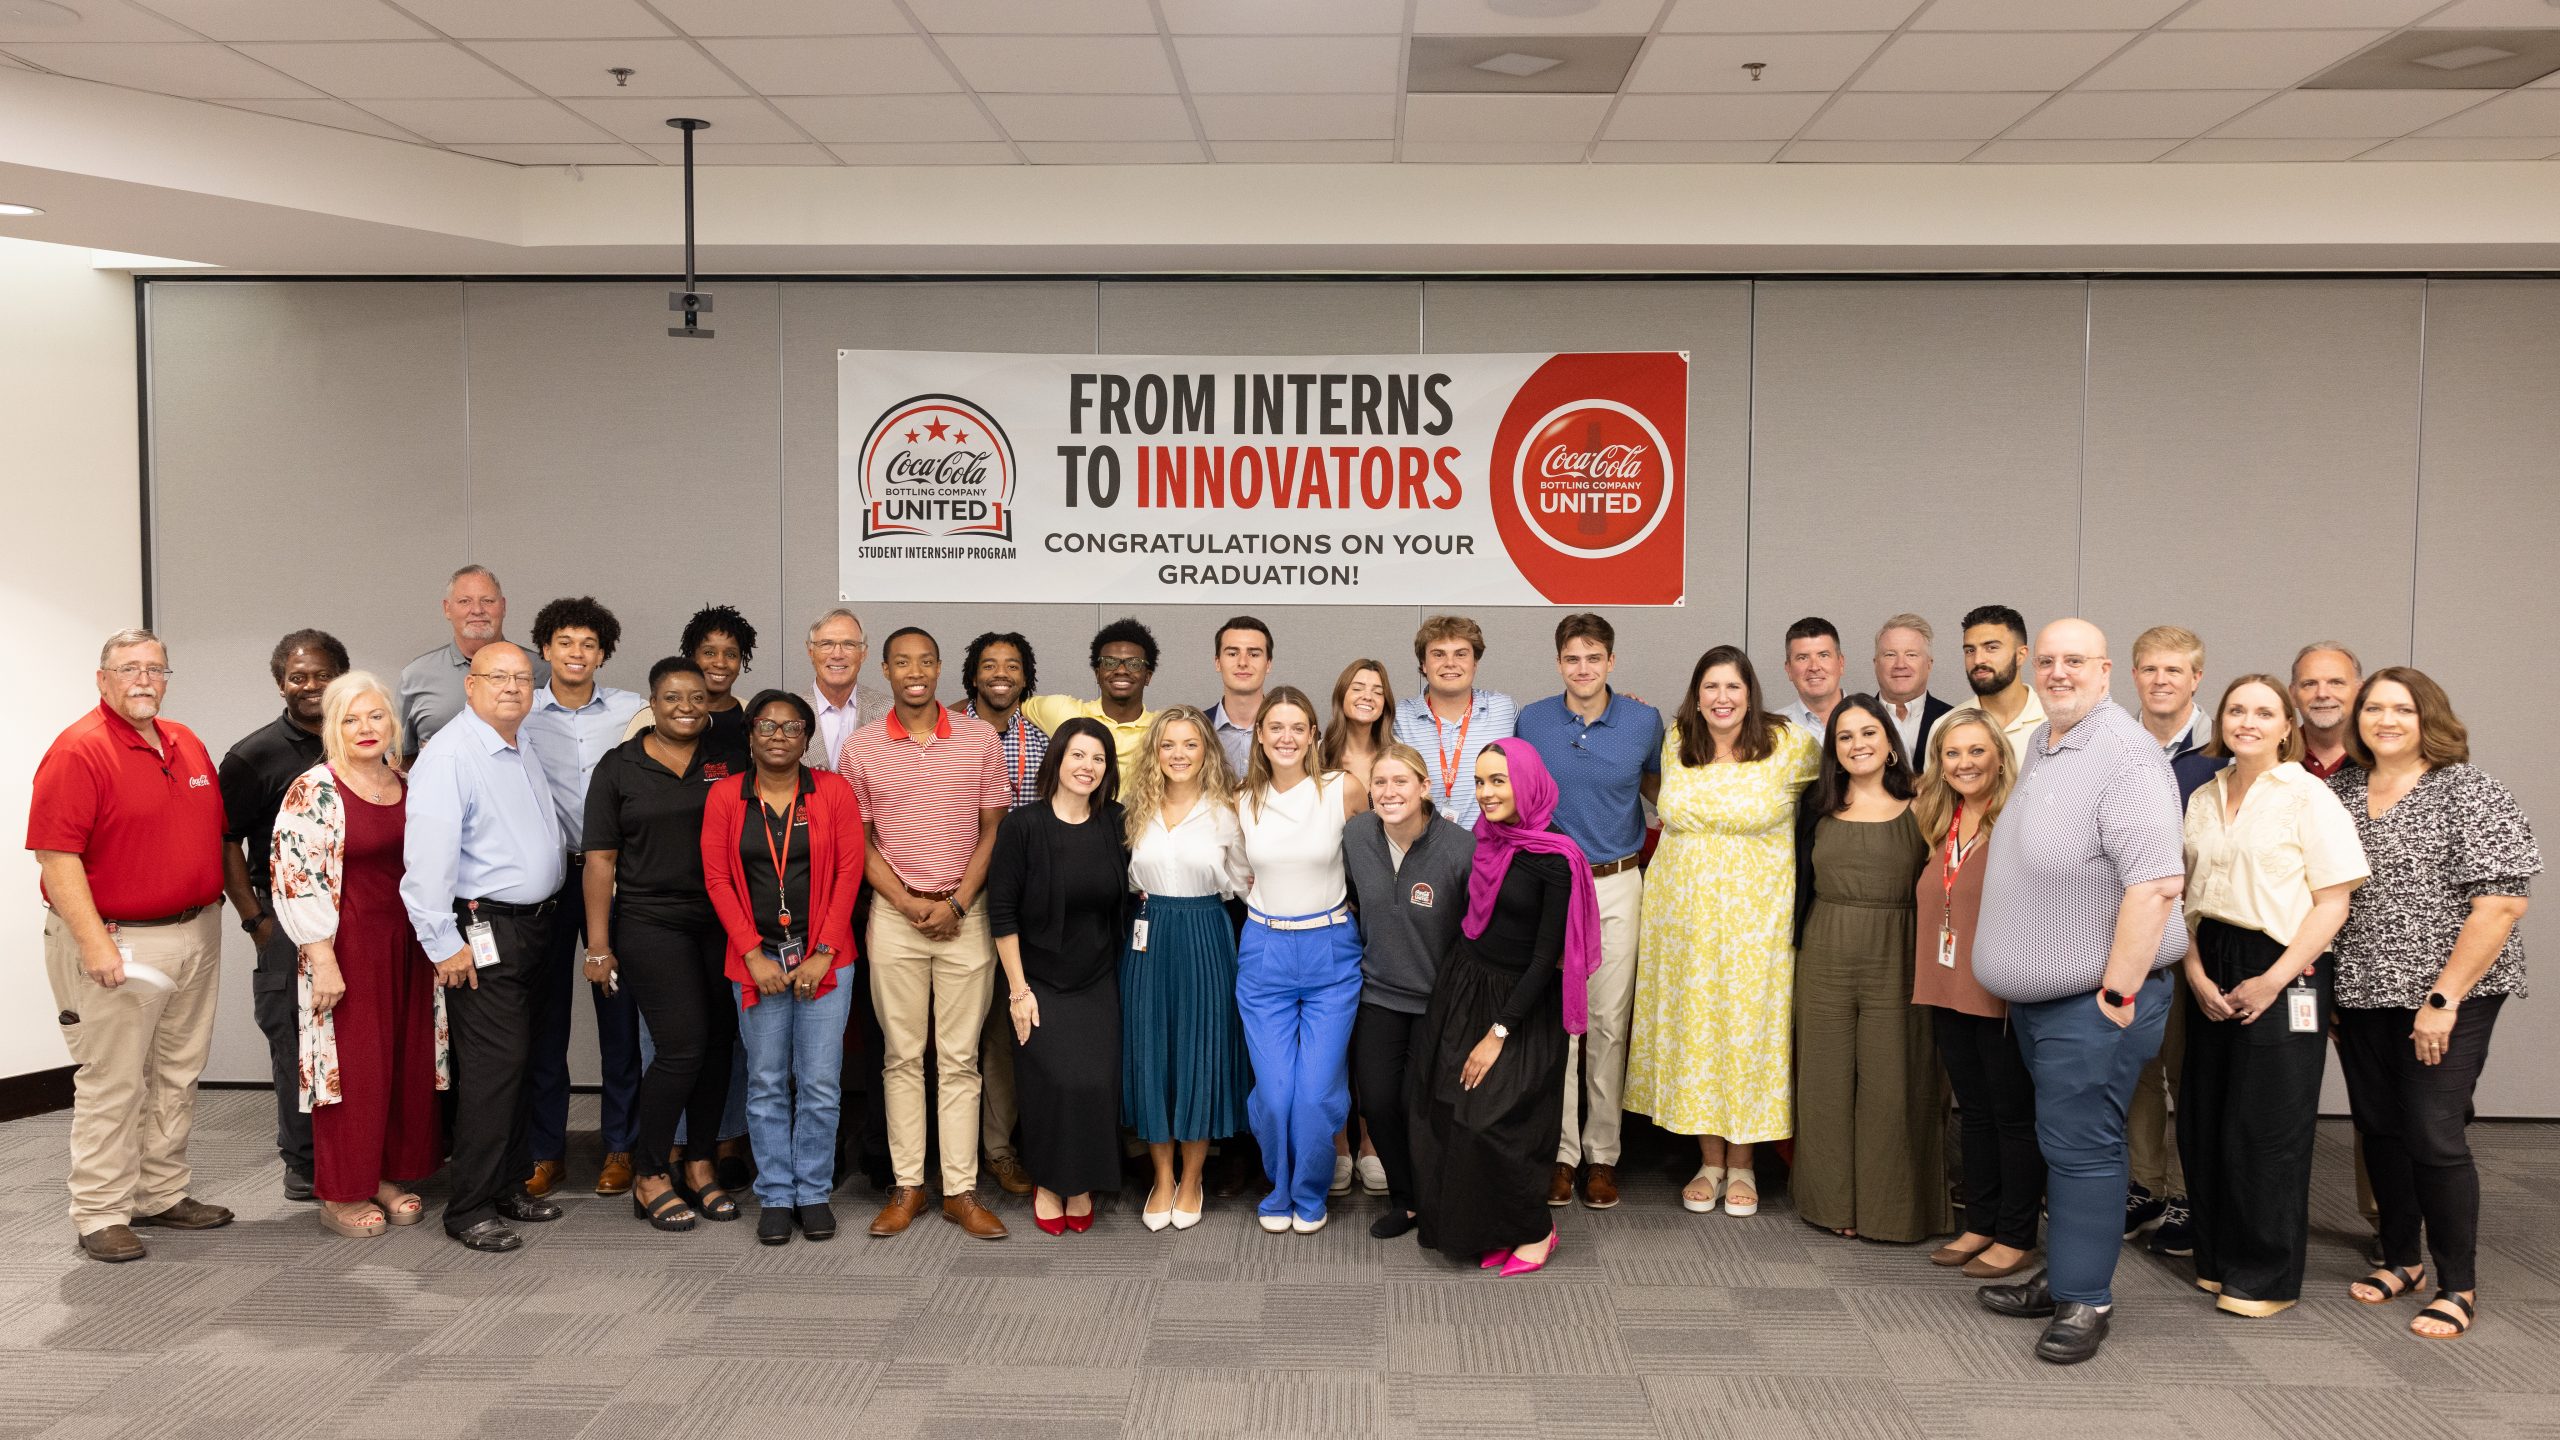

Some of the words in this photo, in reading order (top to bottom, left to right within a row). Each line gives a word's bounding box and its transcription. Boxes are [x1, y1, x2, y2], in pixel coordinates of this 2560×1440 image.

[1069, 373, 1216, 436] FROM
[1233, 372, 1454, 436] INTERNS
[885, 450, 994, 485] Coca-Cola
[1540, 444, 1648, 479] Coca-Cola
[1057, 444, 1121, 509] TO
[1137, 445, 1463, 510] INNOVATORS
[1540, 481, 1590, 490] BOTTLING
[1592, 481, 1642, 490] COMPANY
[885, 488, 935, 496] BOTTLING
[937, 488, 987, 497] COMPANY
[1539, 492, 1642, 514] UNITED
[885, 499, 988, 521] UNITED
[858, 546, 903, 559] STUDENT
[905, 546, 965, 559] INTERNSHIP
[967, 547, 1017, 560] PROGRAM
[1044, 532, 1332, 555] CONGRATULATIONS
[1341, 534, 1384, 555] ON
[1392, 534, 1475, 555] YOUR
[1158, 564, 1359, 586] GRADUATION!
